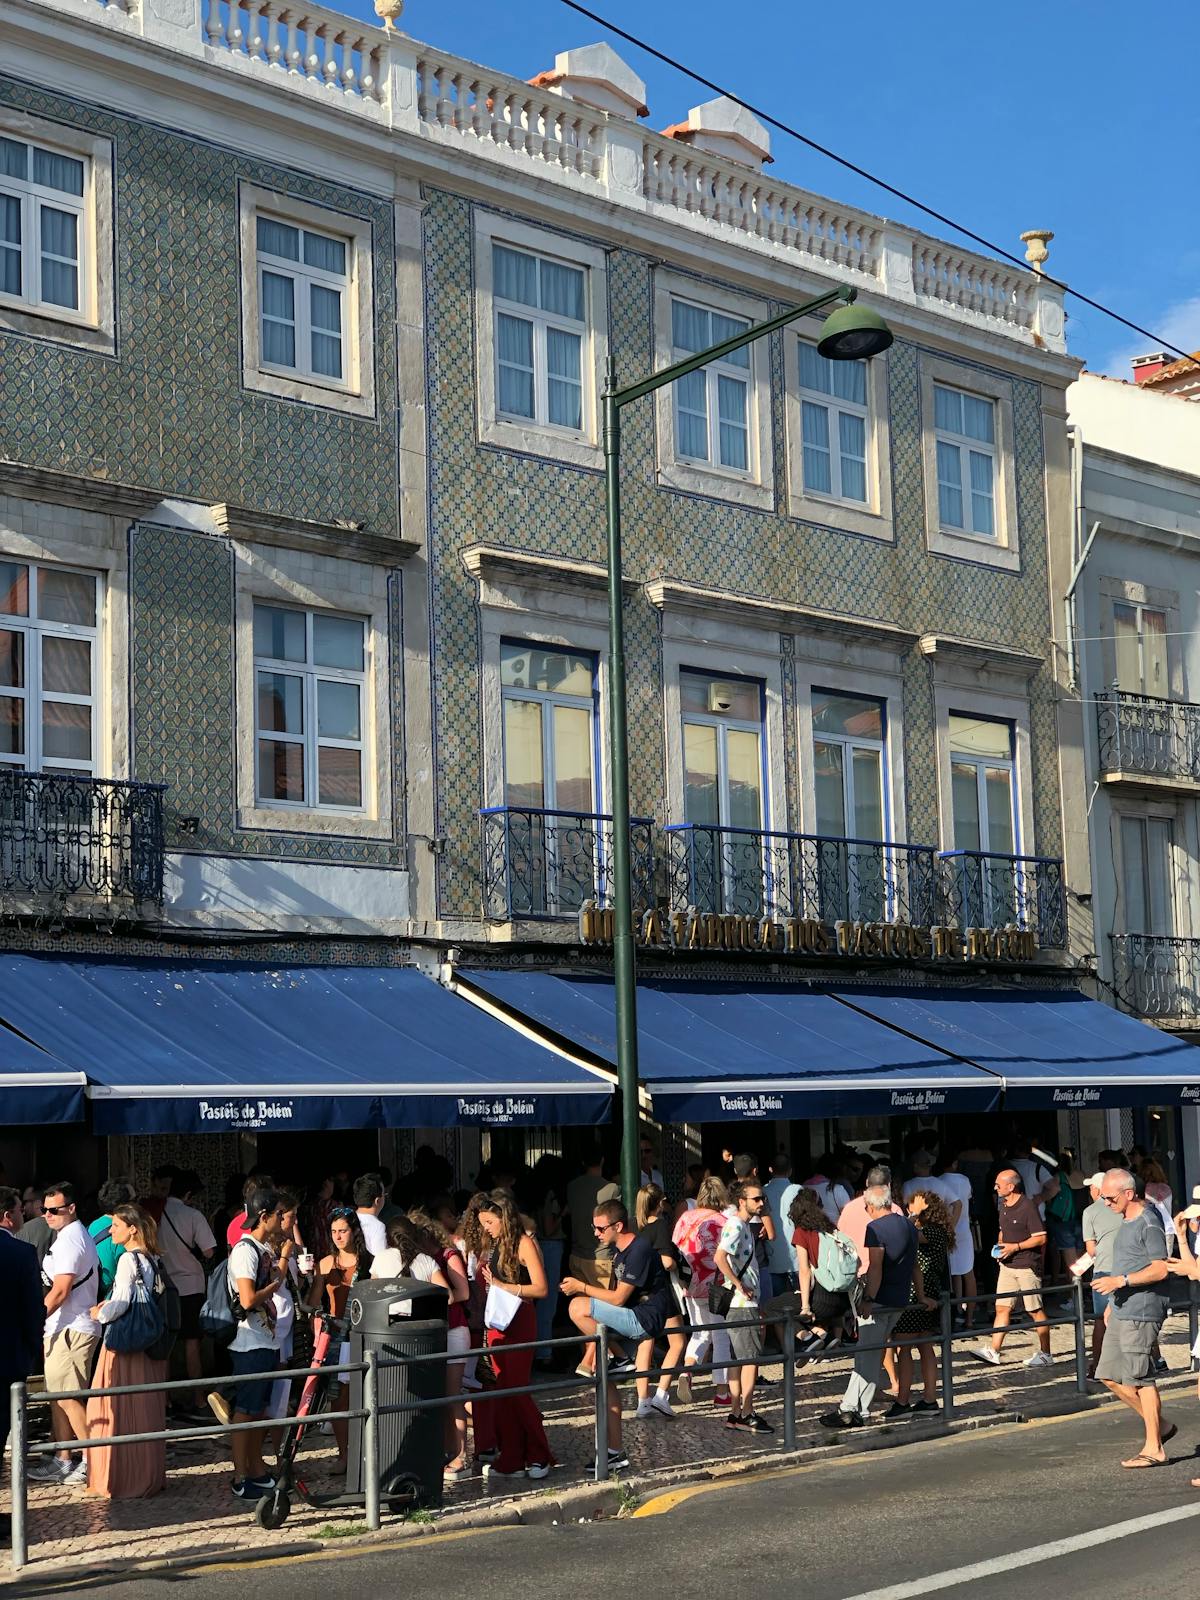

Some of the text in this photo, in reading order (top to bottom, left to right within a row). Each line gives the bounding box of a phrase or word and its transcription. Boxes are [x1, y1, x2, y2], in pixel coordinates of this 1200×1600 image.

[930, 925, 960, 961] DE
[719, 1094, 782, 1111] Pastéis de Belém
[891, 1090, 945, 1106] Pastéis de Belém
[1074, 1090, 1083, 1101] de
[199, 1101, 292, 1120] Pastéis de Belém
[457, 1098, 535, 1115] Pastéis de Belém
